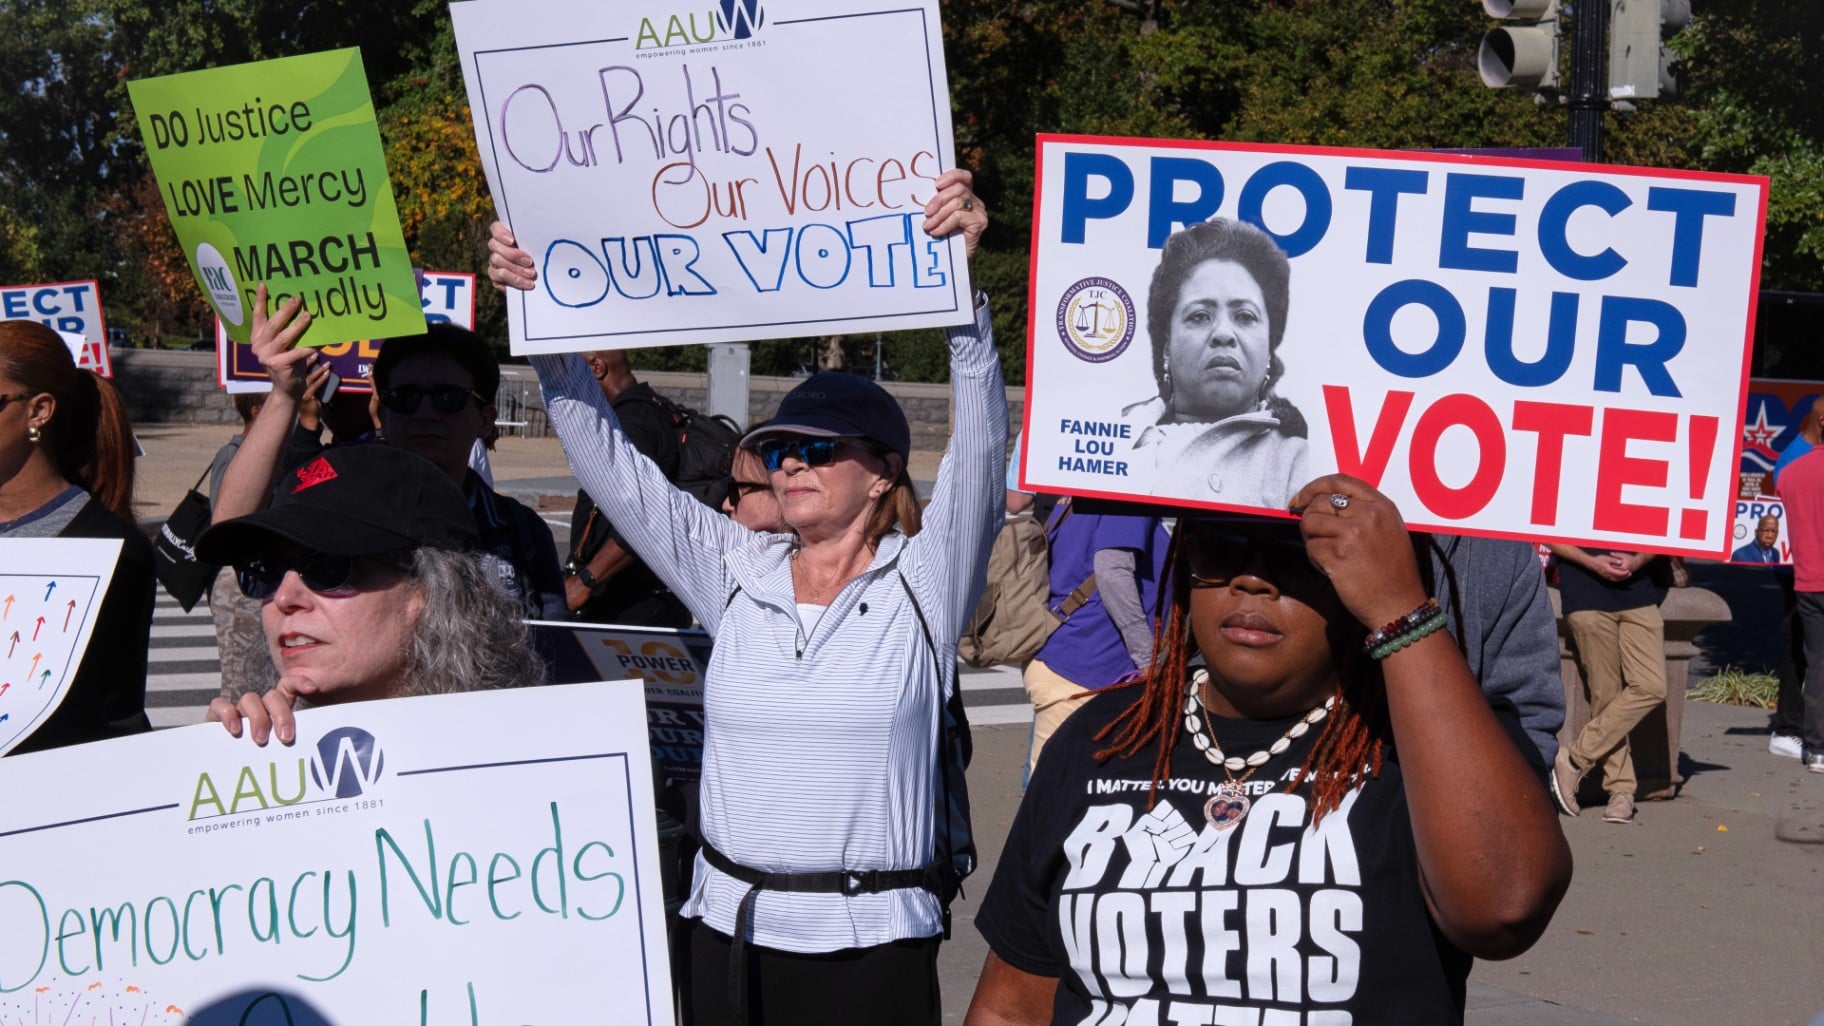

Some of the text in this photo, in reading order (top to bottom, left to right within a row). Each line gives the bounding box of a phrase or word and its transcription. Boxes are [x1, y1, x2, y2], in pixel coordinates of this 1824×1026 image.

[635, 0, 764, 50] AAUW
[636, 40, 767, 59] empowering women since 1881
[150, 97, 312, 150] DO Justice
[501, 64, 758, 184] Our Rights
[168, 168, 367, 217] LOVE Mercy
[651, 143, 937, 229] Our Voices
[1060, 151, 1737, 288] PROTECT
[233, 231, 380, 282] MARCH
[543, 233, 717, 308] OUR
[723, 213, 947, 293] VOTE
[1087, 290, 1107, 299] TJC
[1096, 279, 1122, 295] JUSTICE
[1364, 279, 1687, 398] OUR
[1061, 419, 1131, 439] FANNIE
[1075, 439, 1114, 456] LOU
[1058, 456, 1128, 477] HAMER
[1322, 385, 1719, 541] VOTE!
[616, 654, 695, 673] POWER
[188, 726, 385, 821] AAUW
[1168, 778, 1205, 793] YOU
[188, 799, 385, 835] empowering women since 1881
[374, 801, 625, 929] Needs
[1058, 888, 1364, 1003] VOTERS
